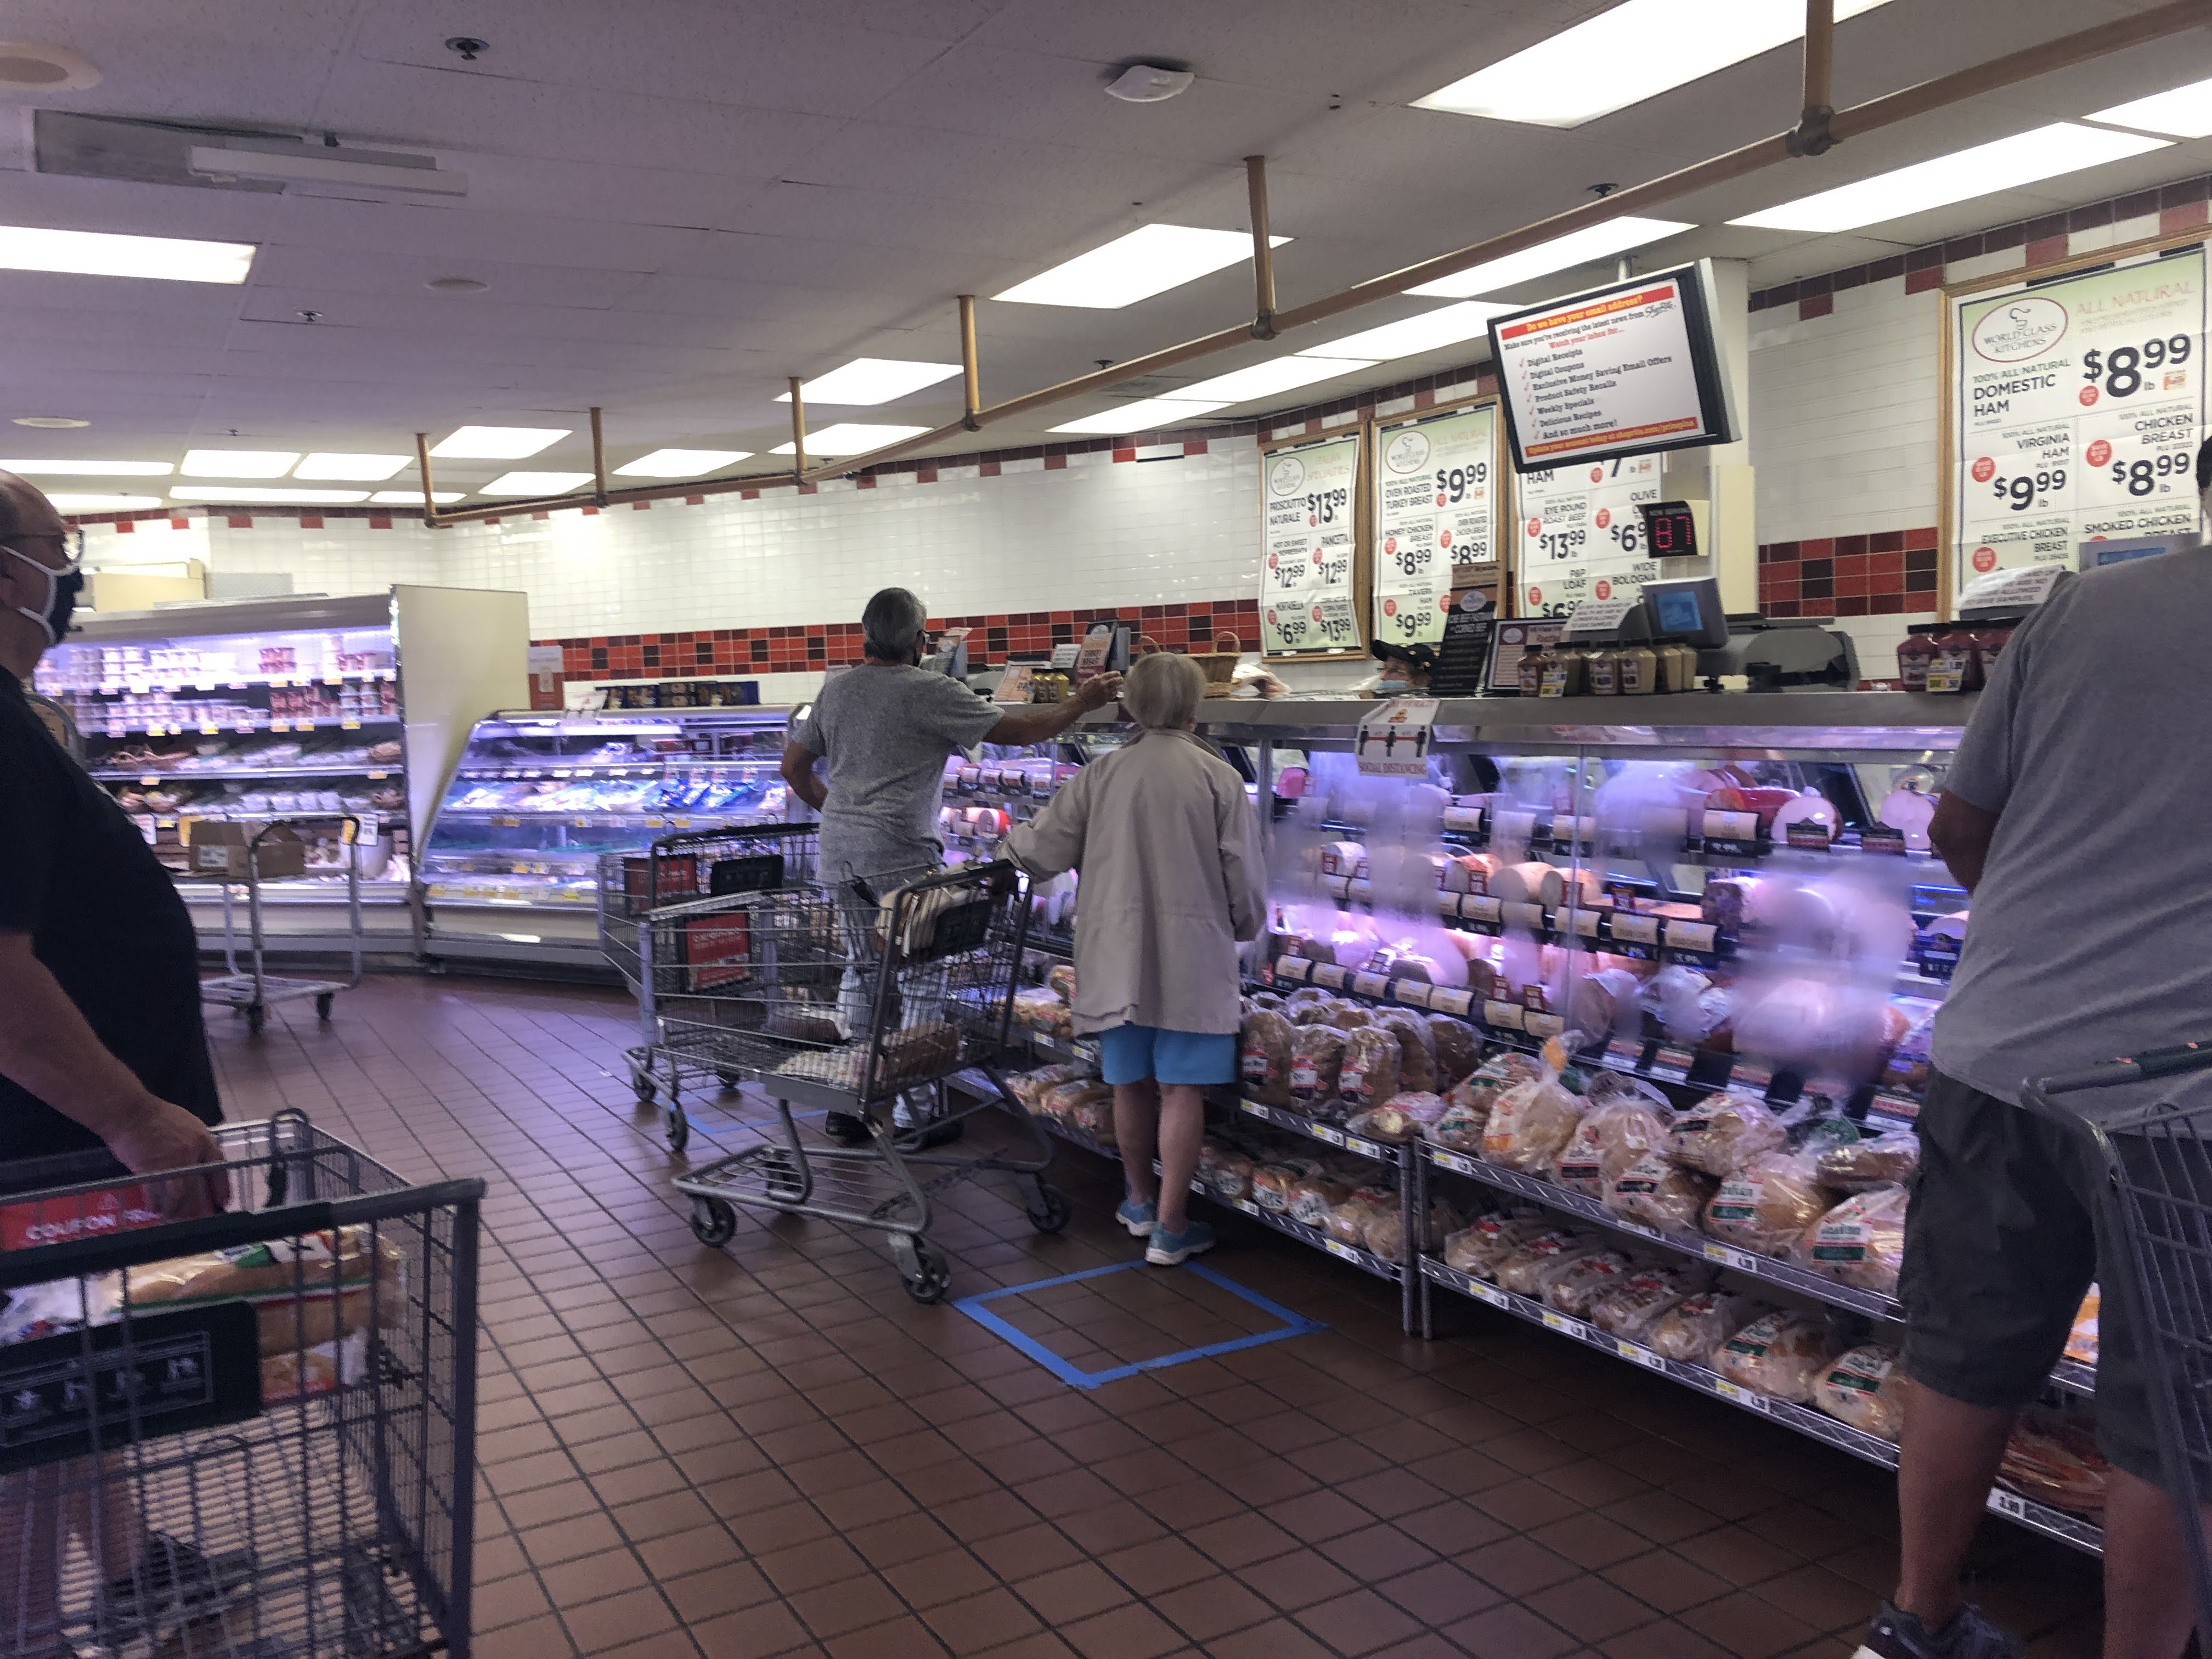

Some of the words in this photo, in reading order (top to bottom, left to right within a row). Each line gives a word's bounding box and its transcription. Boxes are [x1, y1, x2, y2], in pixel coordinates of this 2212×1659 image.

[2076, 299, 2107, 316] ALL
[2112, 281, 2195, 307] NATURAL
[2022, 323, 2057, 336] CLASS
[1527, 355, 1551, 366] Digital
[1551, 349, 1583, 361] Receipts
[1530, 368, 1554, 379] Digital
[1554, 362, 1585, 374] Coupons
[1568, 373, 1594, 383] Money
[1972, 373, 1999, 383] 100%
[2001, 368, 2019, 379] ALL
[2021, 358, 2072, 374] NATURAL
[1564, 387, 1587, 396] Safety
[1973, 374, 2057, 400] DOMESTIC
[1573, 410, 1602, 421] Recipes
[1973, 399, 2010, 417] HAM
[2134, 413, 2194, 431] CHICKEN
[2016, 432, 2070, 449] VIRGINIA
[2141, 428, 2194, 444] BREAST
[2042, 447, 2070, 459] HAM
[1527, 469, 1554, 485] HAM
[1385, 487, 1402, 498] OVEN
[1403, 483, 1432, 495] ROASTED
[1629, 489, 1657, 502] OLIVE
[1385, 498, 1408, 510] TURKEY
[1409, 494, 1433, 506] BREAST
[1544, 506, 1559, 515] EYE
[1559, 502, 1587, 514] ROUND
[1269, 511, 1301, 526] NATURALE
[1568, 512, 1587, 522] BEEF
[2085, 519, 2135, 534] SMOKED
[2138, 513, 2192, 528] CHICKEN
[1406, 524, 1434, 534] CHICKEN
[2033, 540, 2069, 553] BREAST
[1564, 579, 1587, 590] LOAF
[1612, 573, 1657, 585] BOLOGNA
